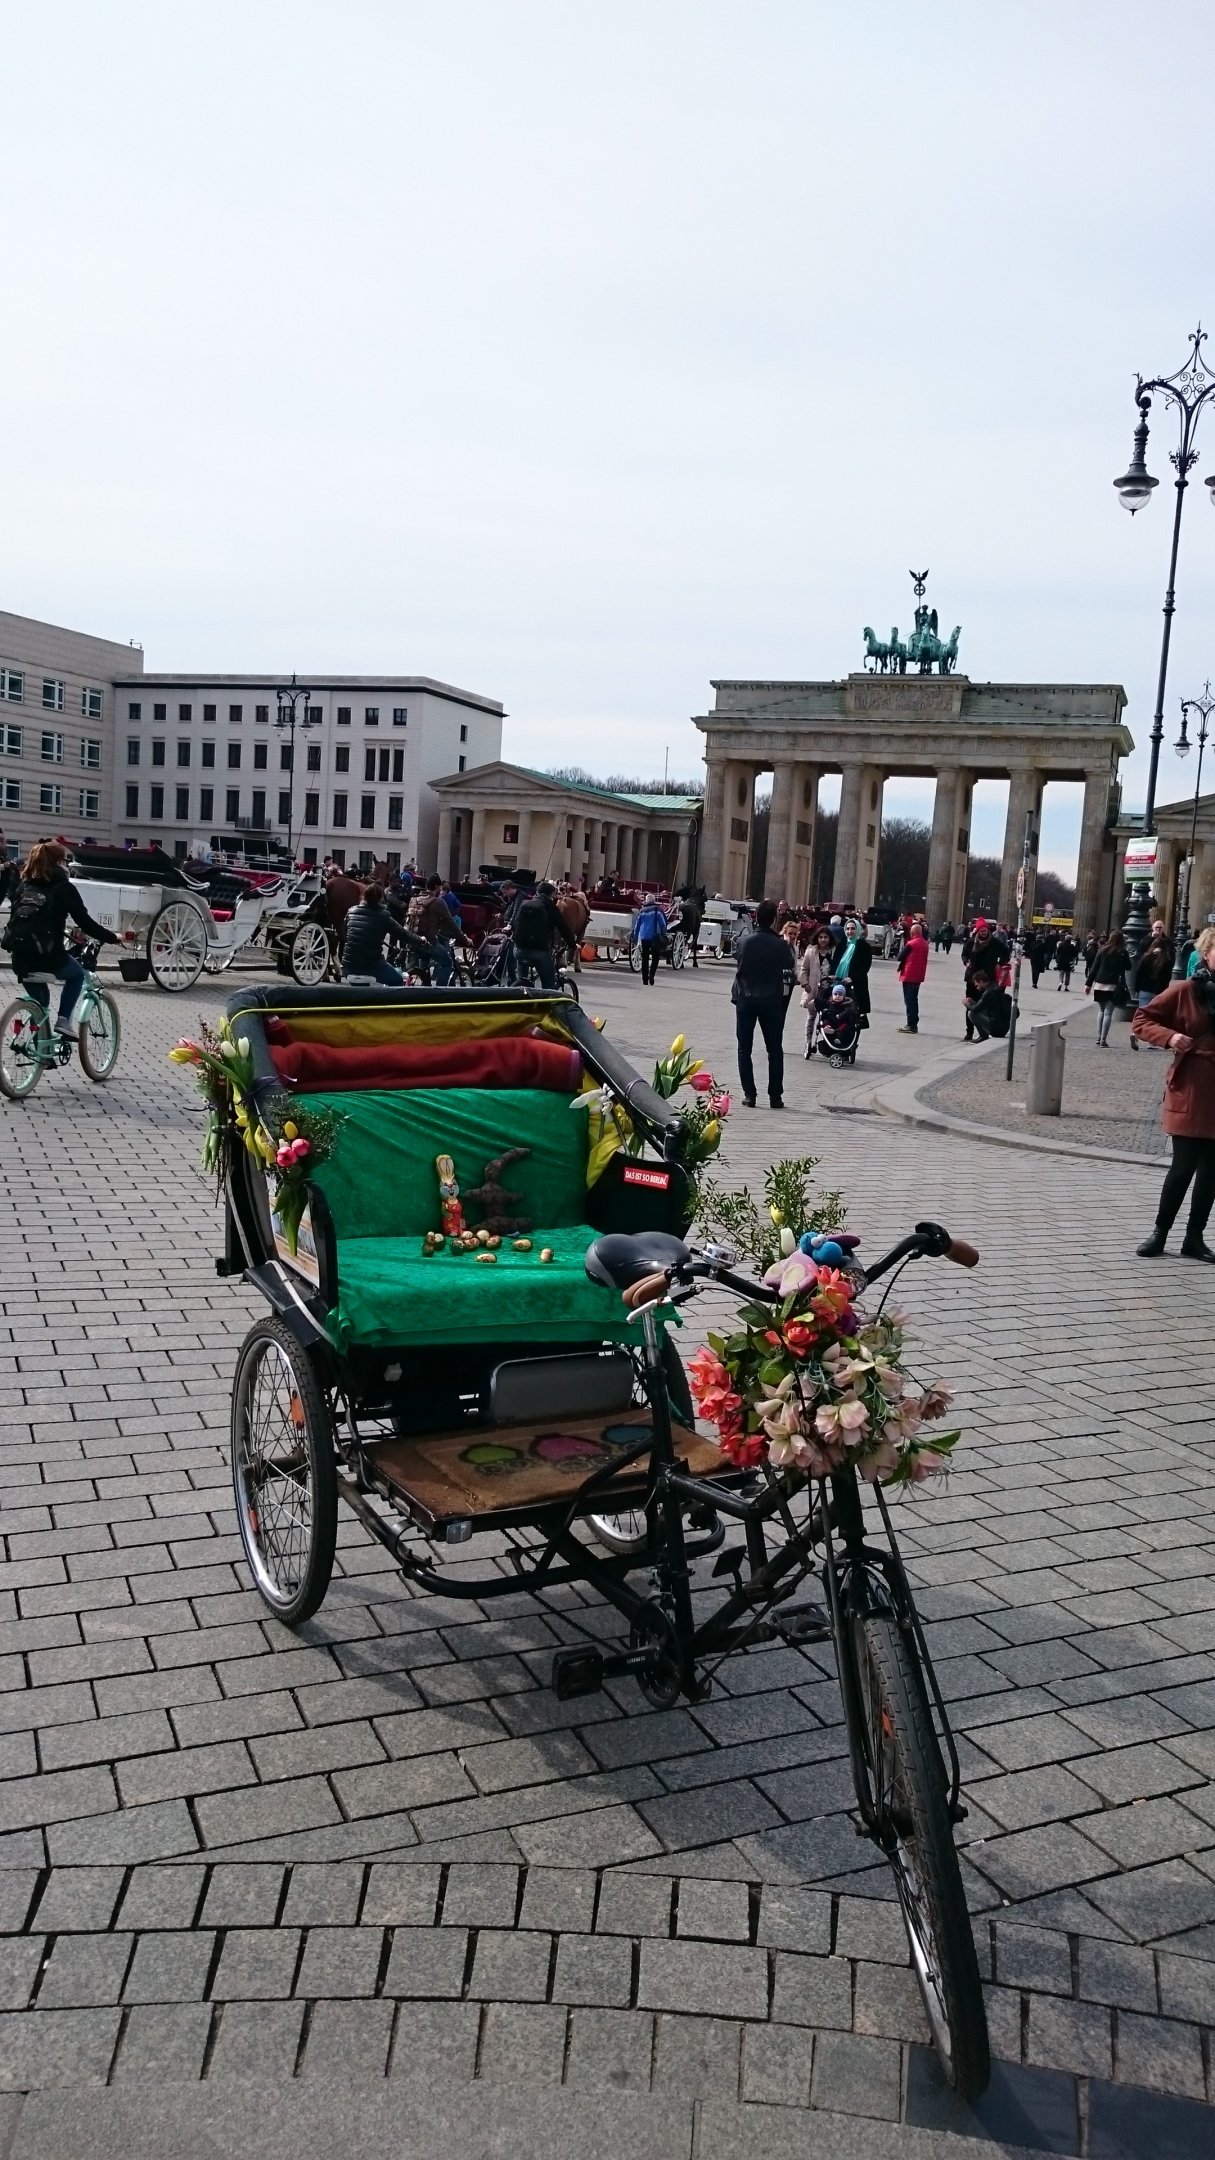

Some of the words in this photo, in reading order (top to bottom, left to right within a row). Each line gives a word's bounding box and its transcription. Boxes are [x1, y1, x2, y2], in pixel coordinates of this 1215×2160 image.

[99, 915, 112, 925] 120
[625, 1171, 635, 1179] DAS
[642, 1173, 649, 1181] SO
